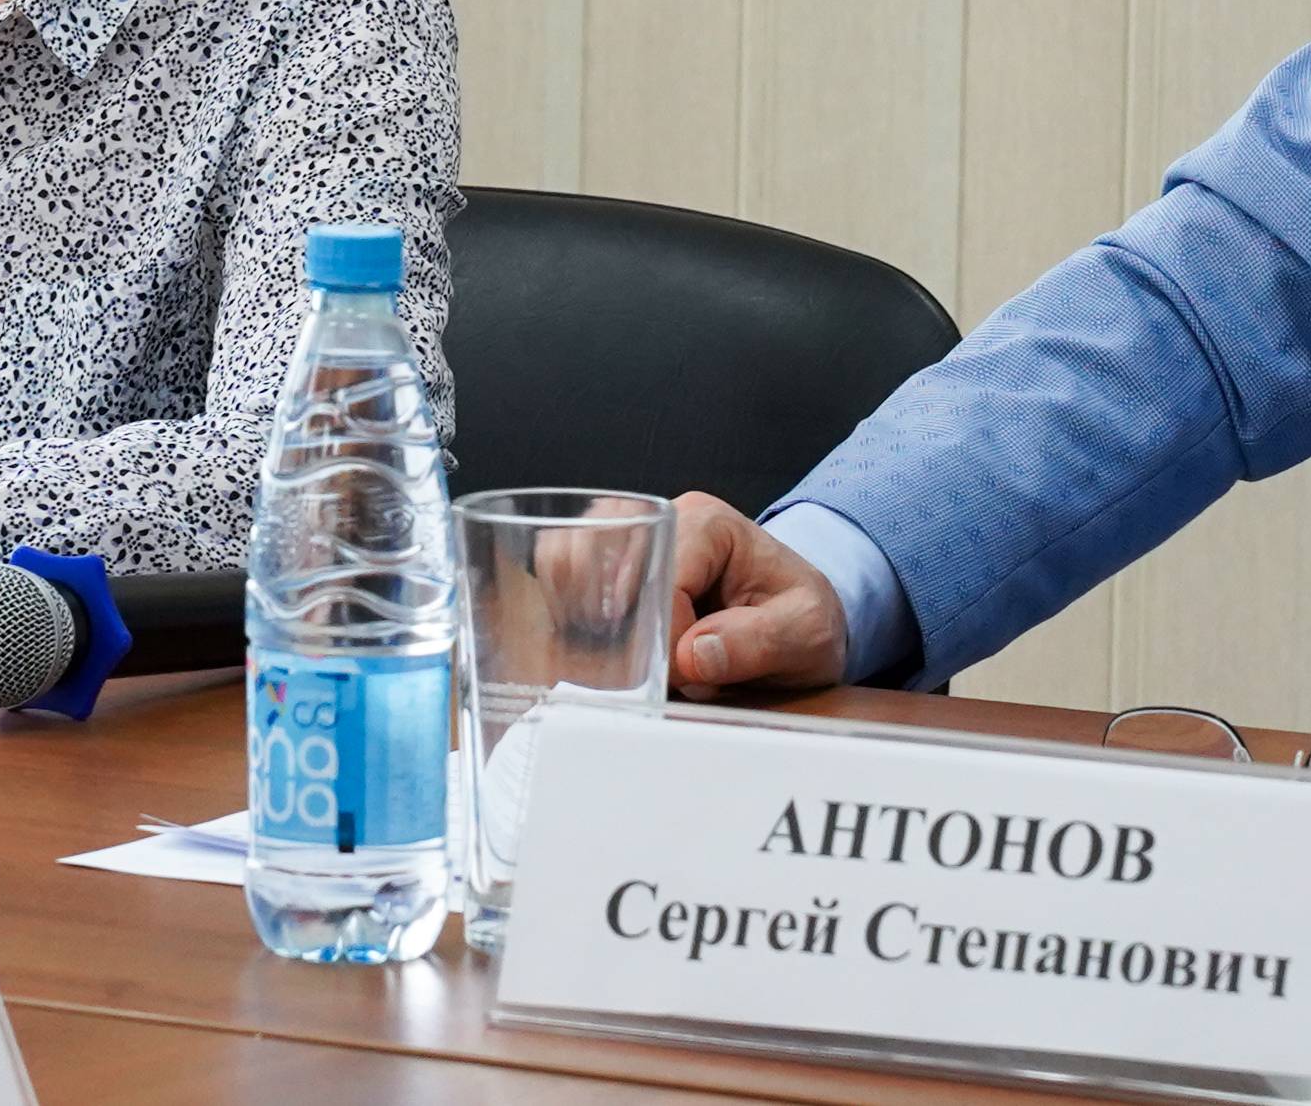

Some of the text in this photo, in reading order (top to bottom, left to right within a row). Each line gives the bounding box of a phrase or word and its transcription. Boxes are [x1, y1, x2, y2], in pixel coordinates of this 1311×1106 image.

[759, 797, 1158, 884] АНТОНОВ
[605, 879, 1292, 998] Сергей Степанович
